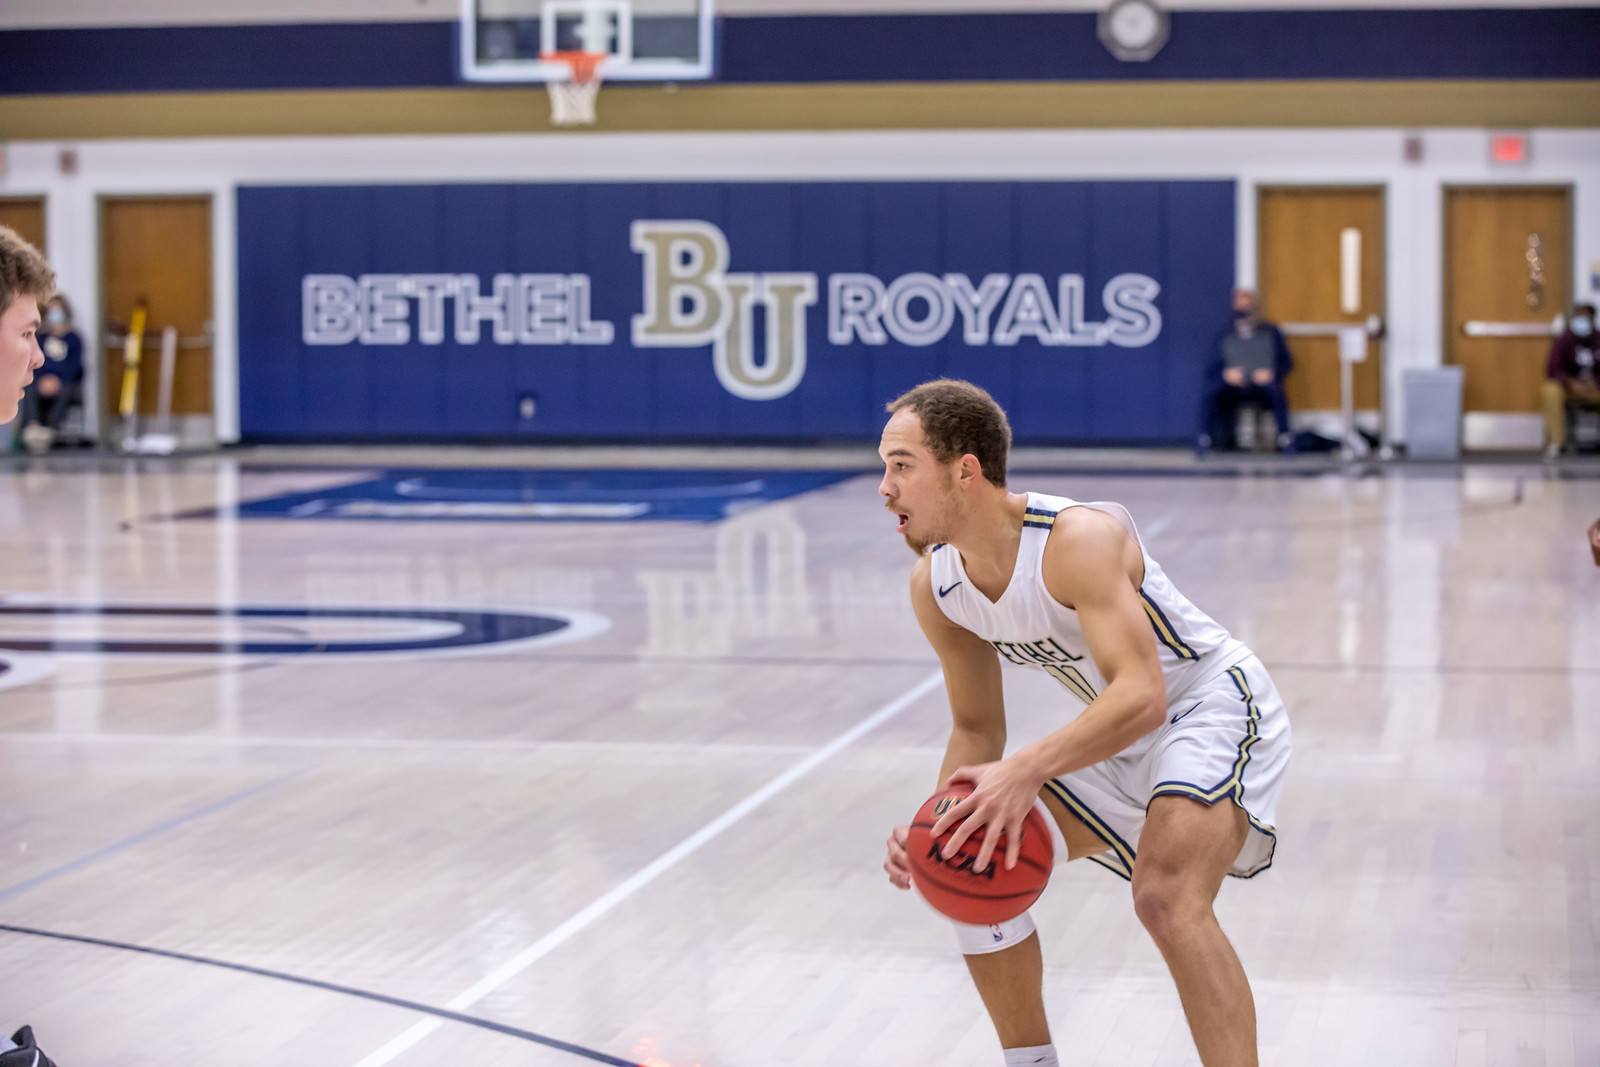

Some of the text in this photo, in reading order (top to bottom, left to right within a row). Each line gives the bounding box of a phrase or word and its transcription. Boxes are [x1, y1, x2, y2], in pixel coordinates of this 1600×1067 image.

[302, 219, 1162, 401] BETHEL BU ROYALS
[987, 637, 1084, 665] ETHEL
